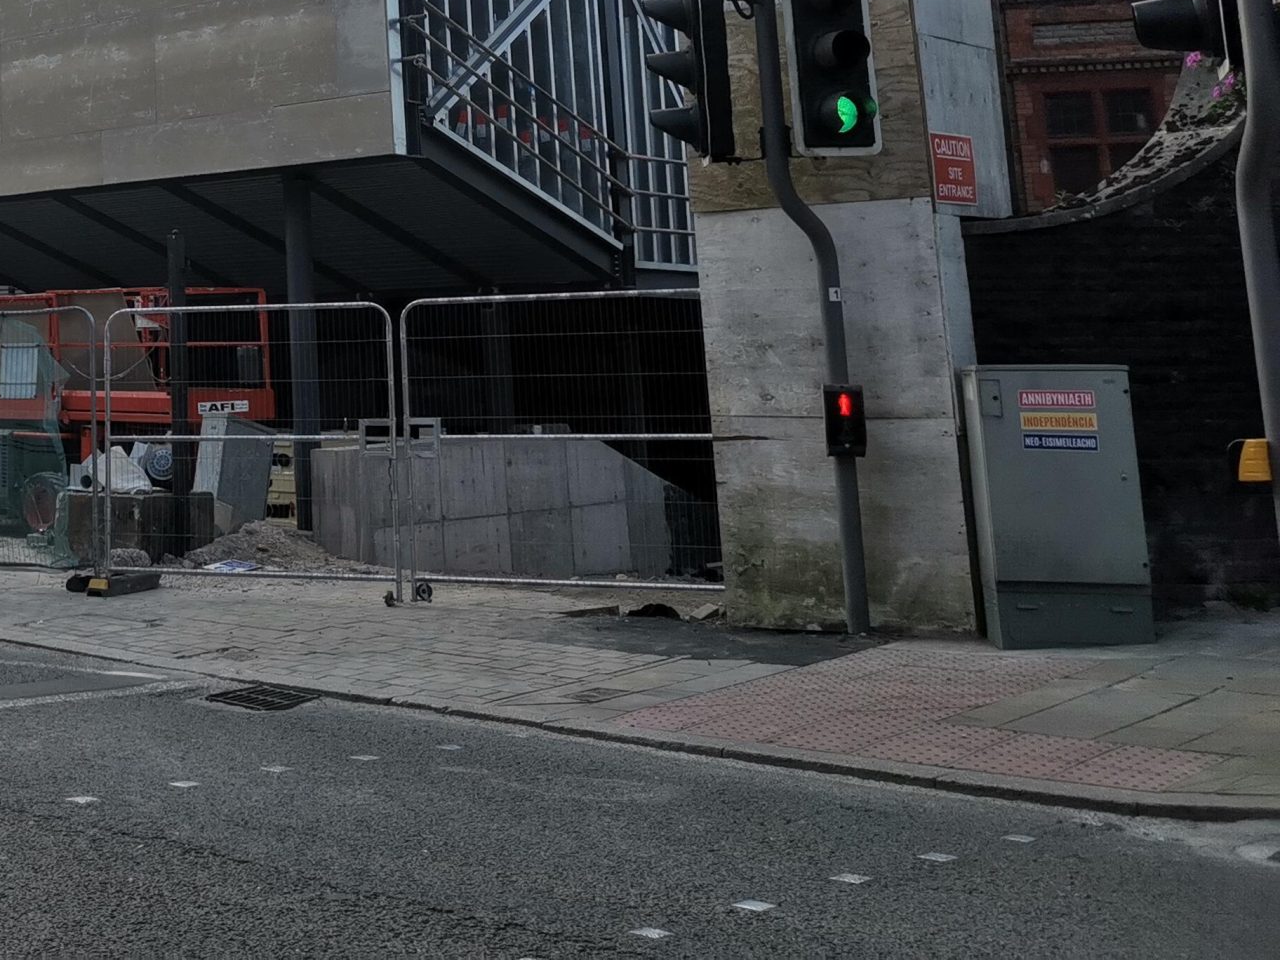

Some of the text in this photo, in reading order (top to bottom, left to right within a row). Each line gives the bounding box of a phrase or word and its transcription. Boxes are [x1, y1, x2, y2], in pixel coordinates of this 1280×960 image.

[934, 138, 971, 157] CAUTION
[948, 166, 963, 181] SITE
[938, 183, 974, 199] ENTRANCE
[1021, 392, 1092, 406] ANNIBYNIAETH
[208, 403, 235, 412] AFI
